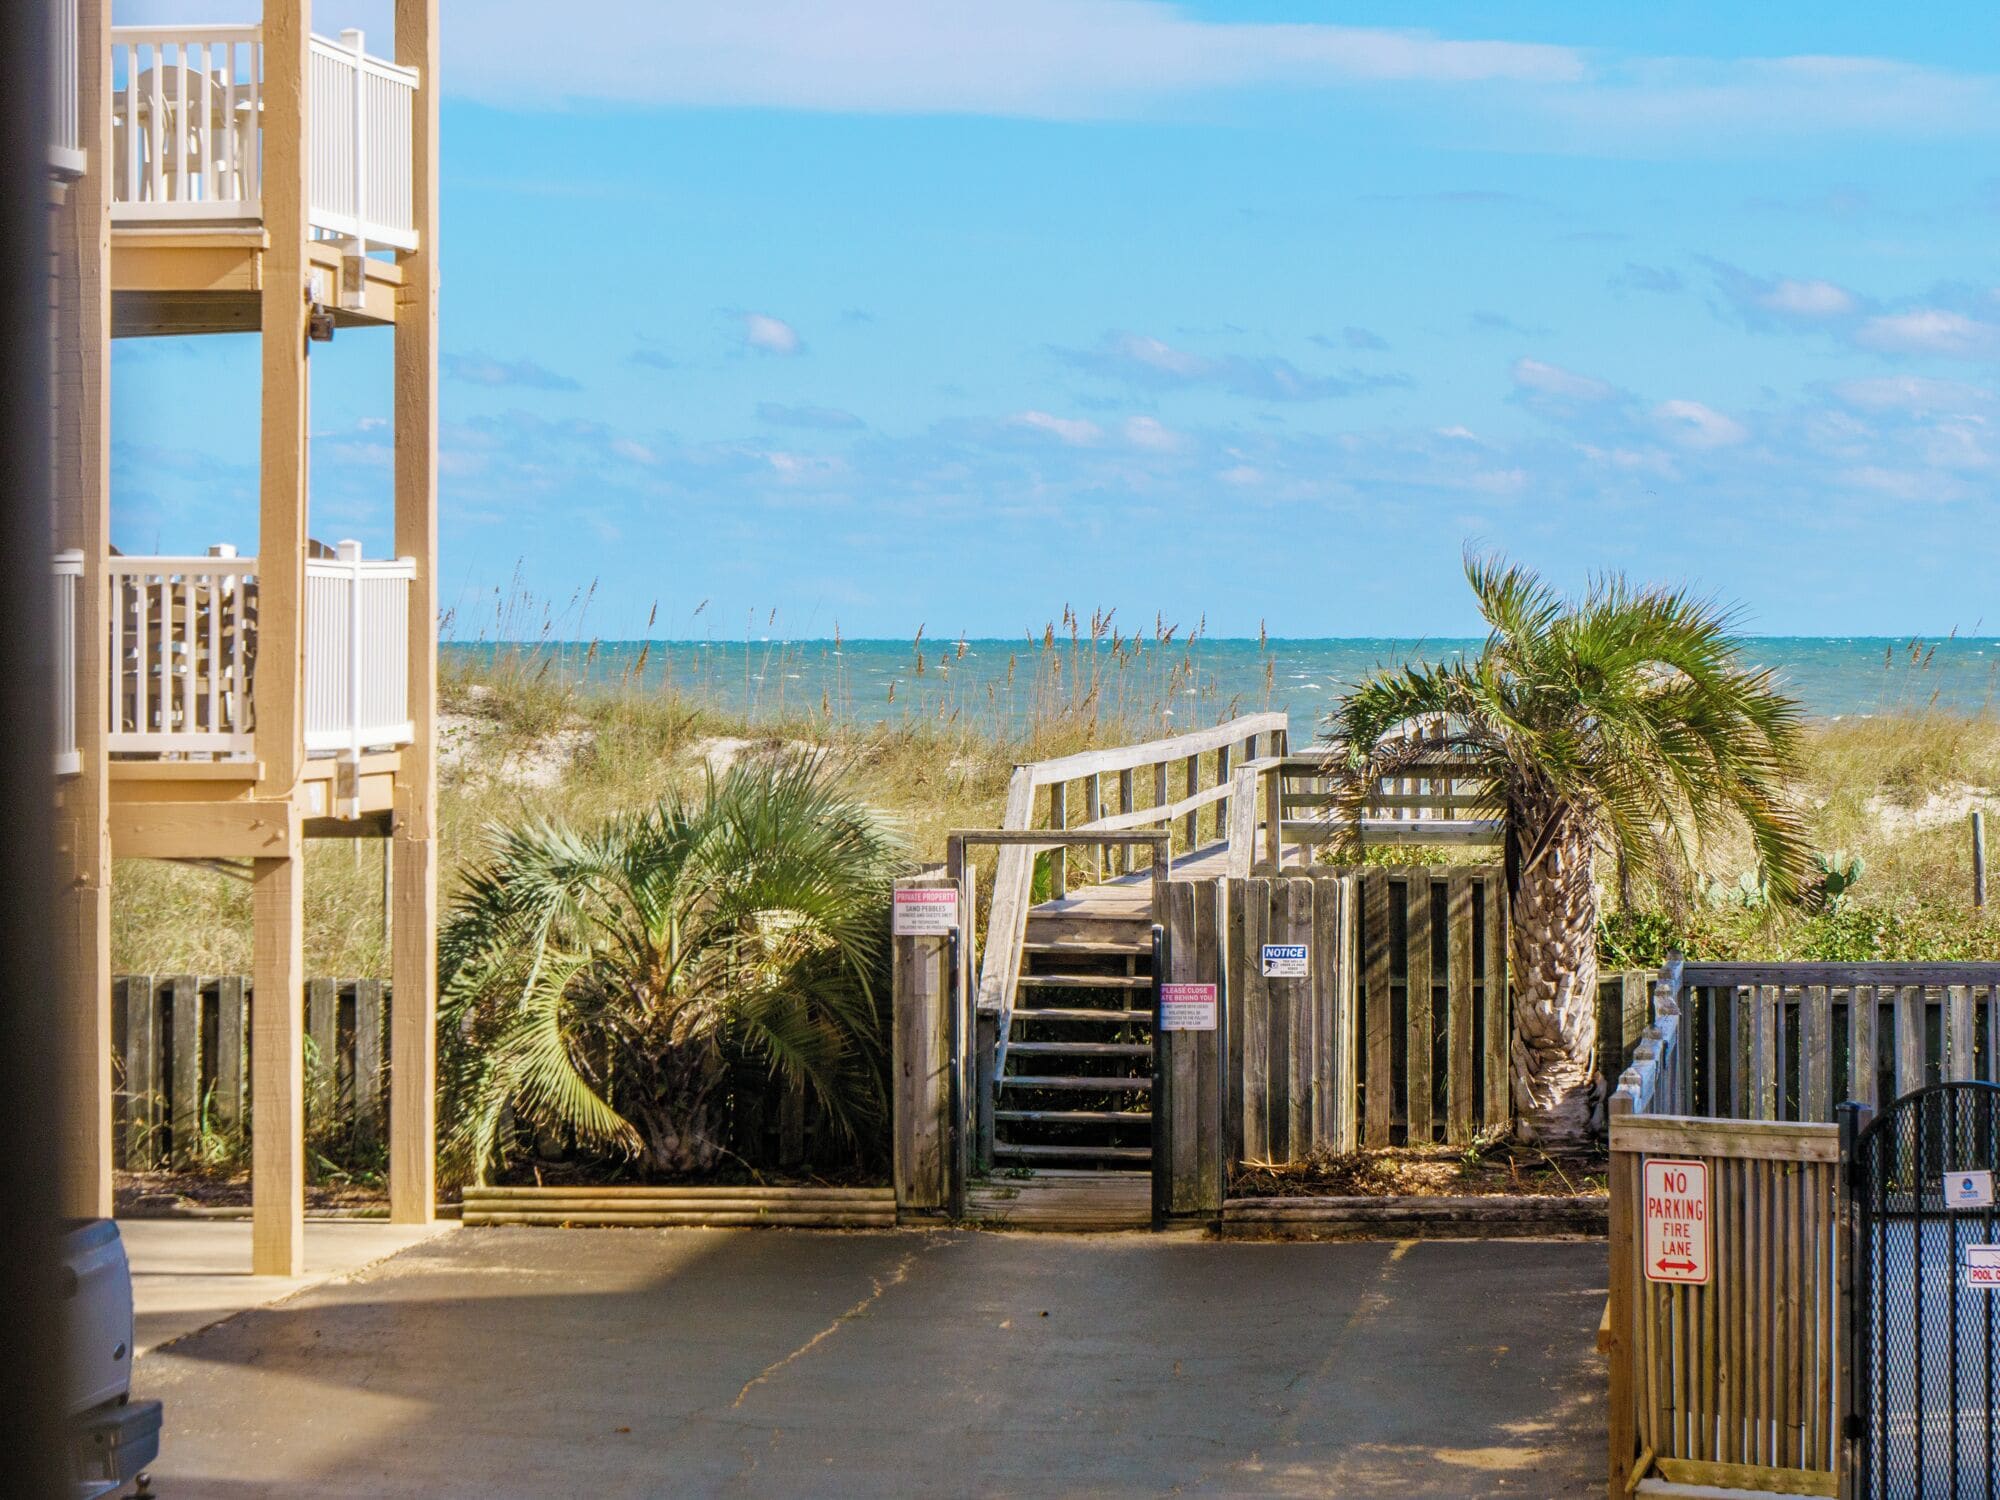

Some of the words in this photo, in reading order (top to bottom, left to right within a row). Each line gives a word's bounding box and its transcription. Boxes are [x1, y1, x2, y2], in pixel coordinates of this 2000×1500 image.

[896, 892, 922, 901] PRIVATE
[922, 892, 955, 901] PROPERTY
[1265, 948, 1305, 958] NOTICE
[1664, 1172, 1687, 1194] NO
[1649, 1198, 1703, 1221] PARKING
[1663, 1222, 1690, 1238] FIRE
[1662, 1241, 1692, 1257] LANE
[1972, 1270, 1992, 1280] POOL
